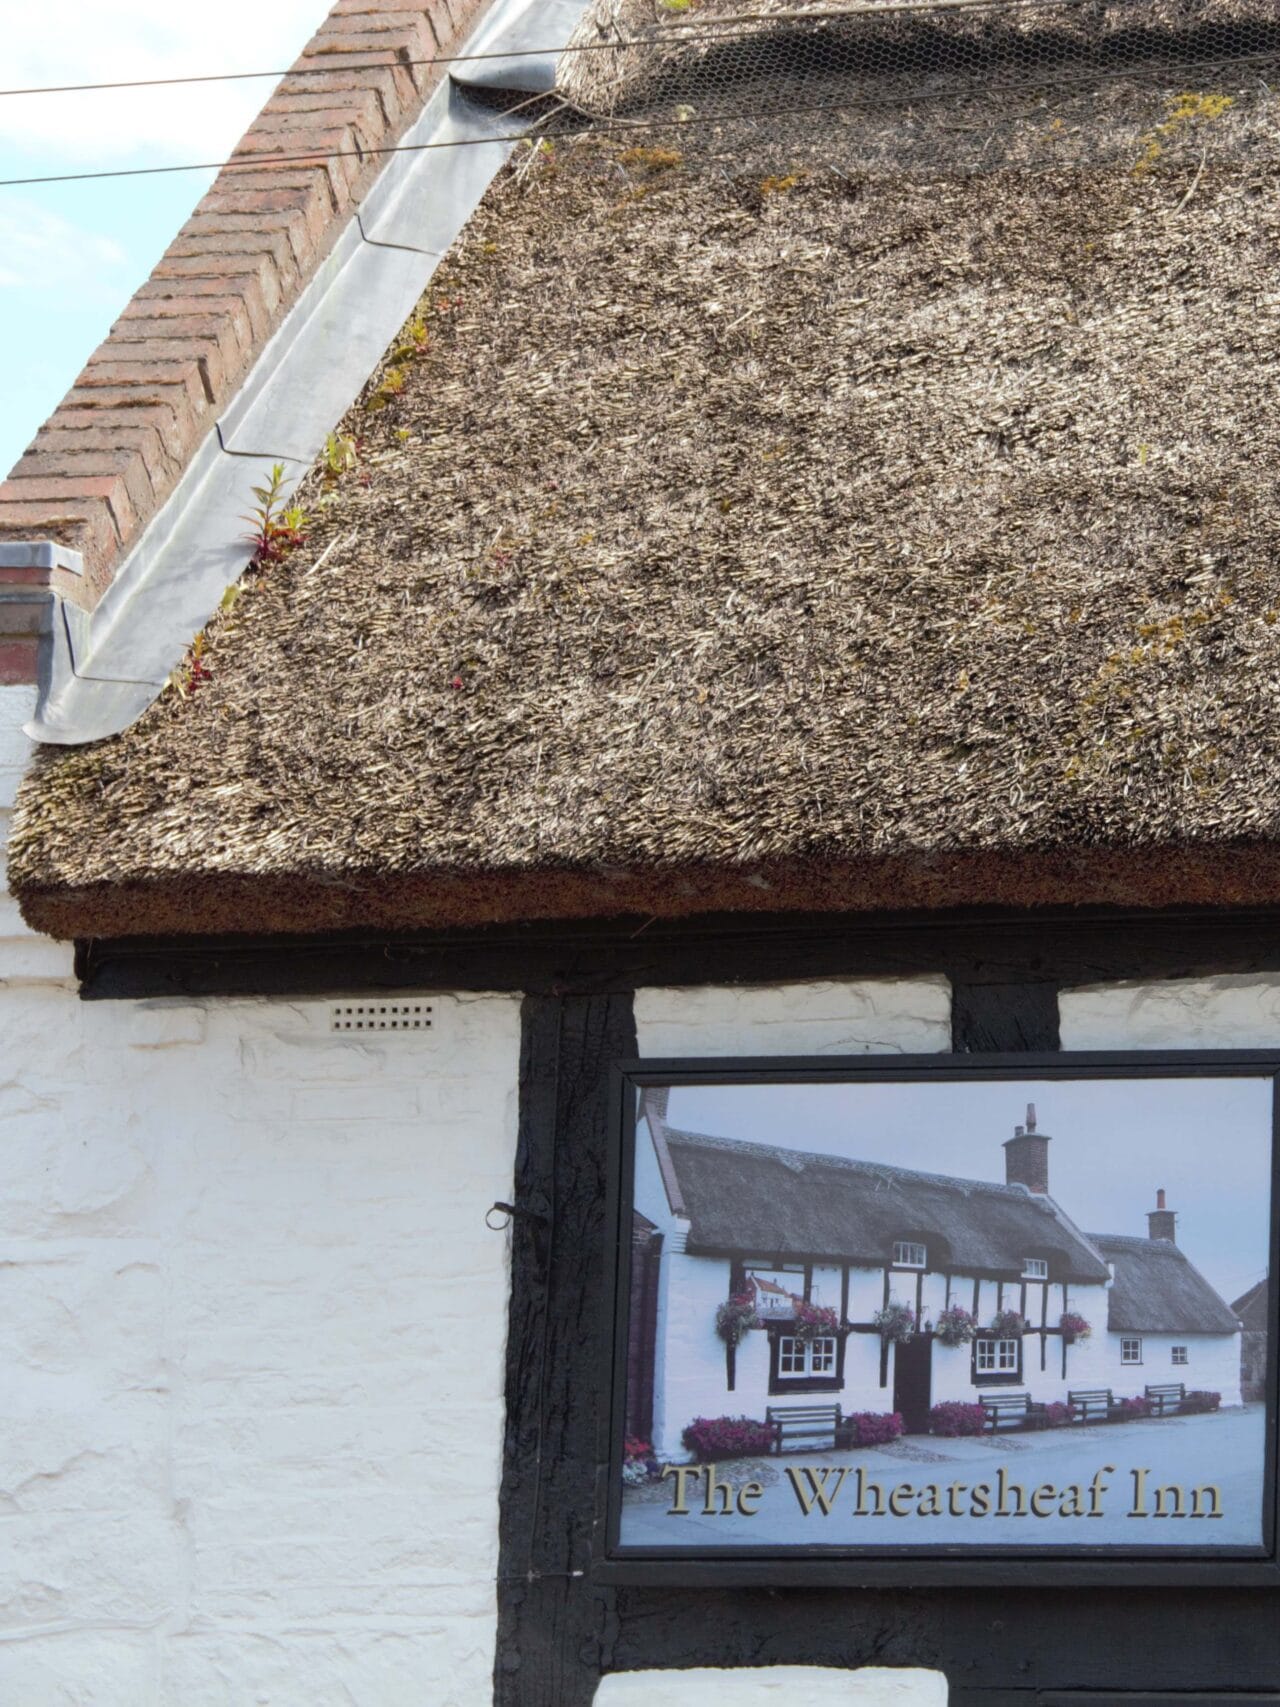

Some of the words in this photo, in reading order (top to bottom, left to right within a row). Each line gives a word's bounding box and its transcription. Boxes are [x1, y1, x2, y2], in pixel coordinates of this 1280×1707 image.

[660, 1464, 764, 1516] The
[784, 1464, 1116, 1518] Wheatsheaf
[1127, 1468, 1224, 1518] Inn
